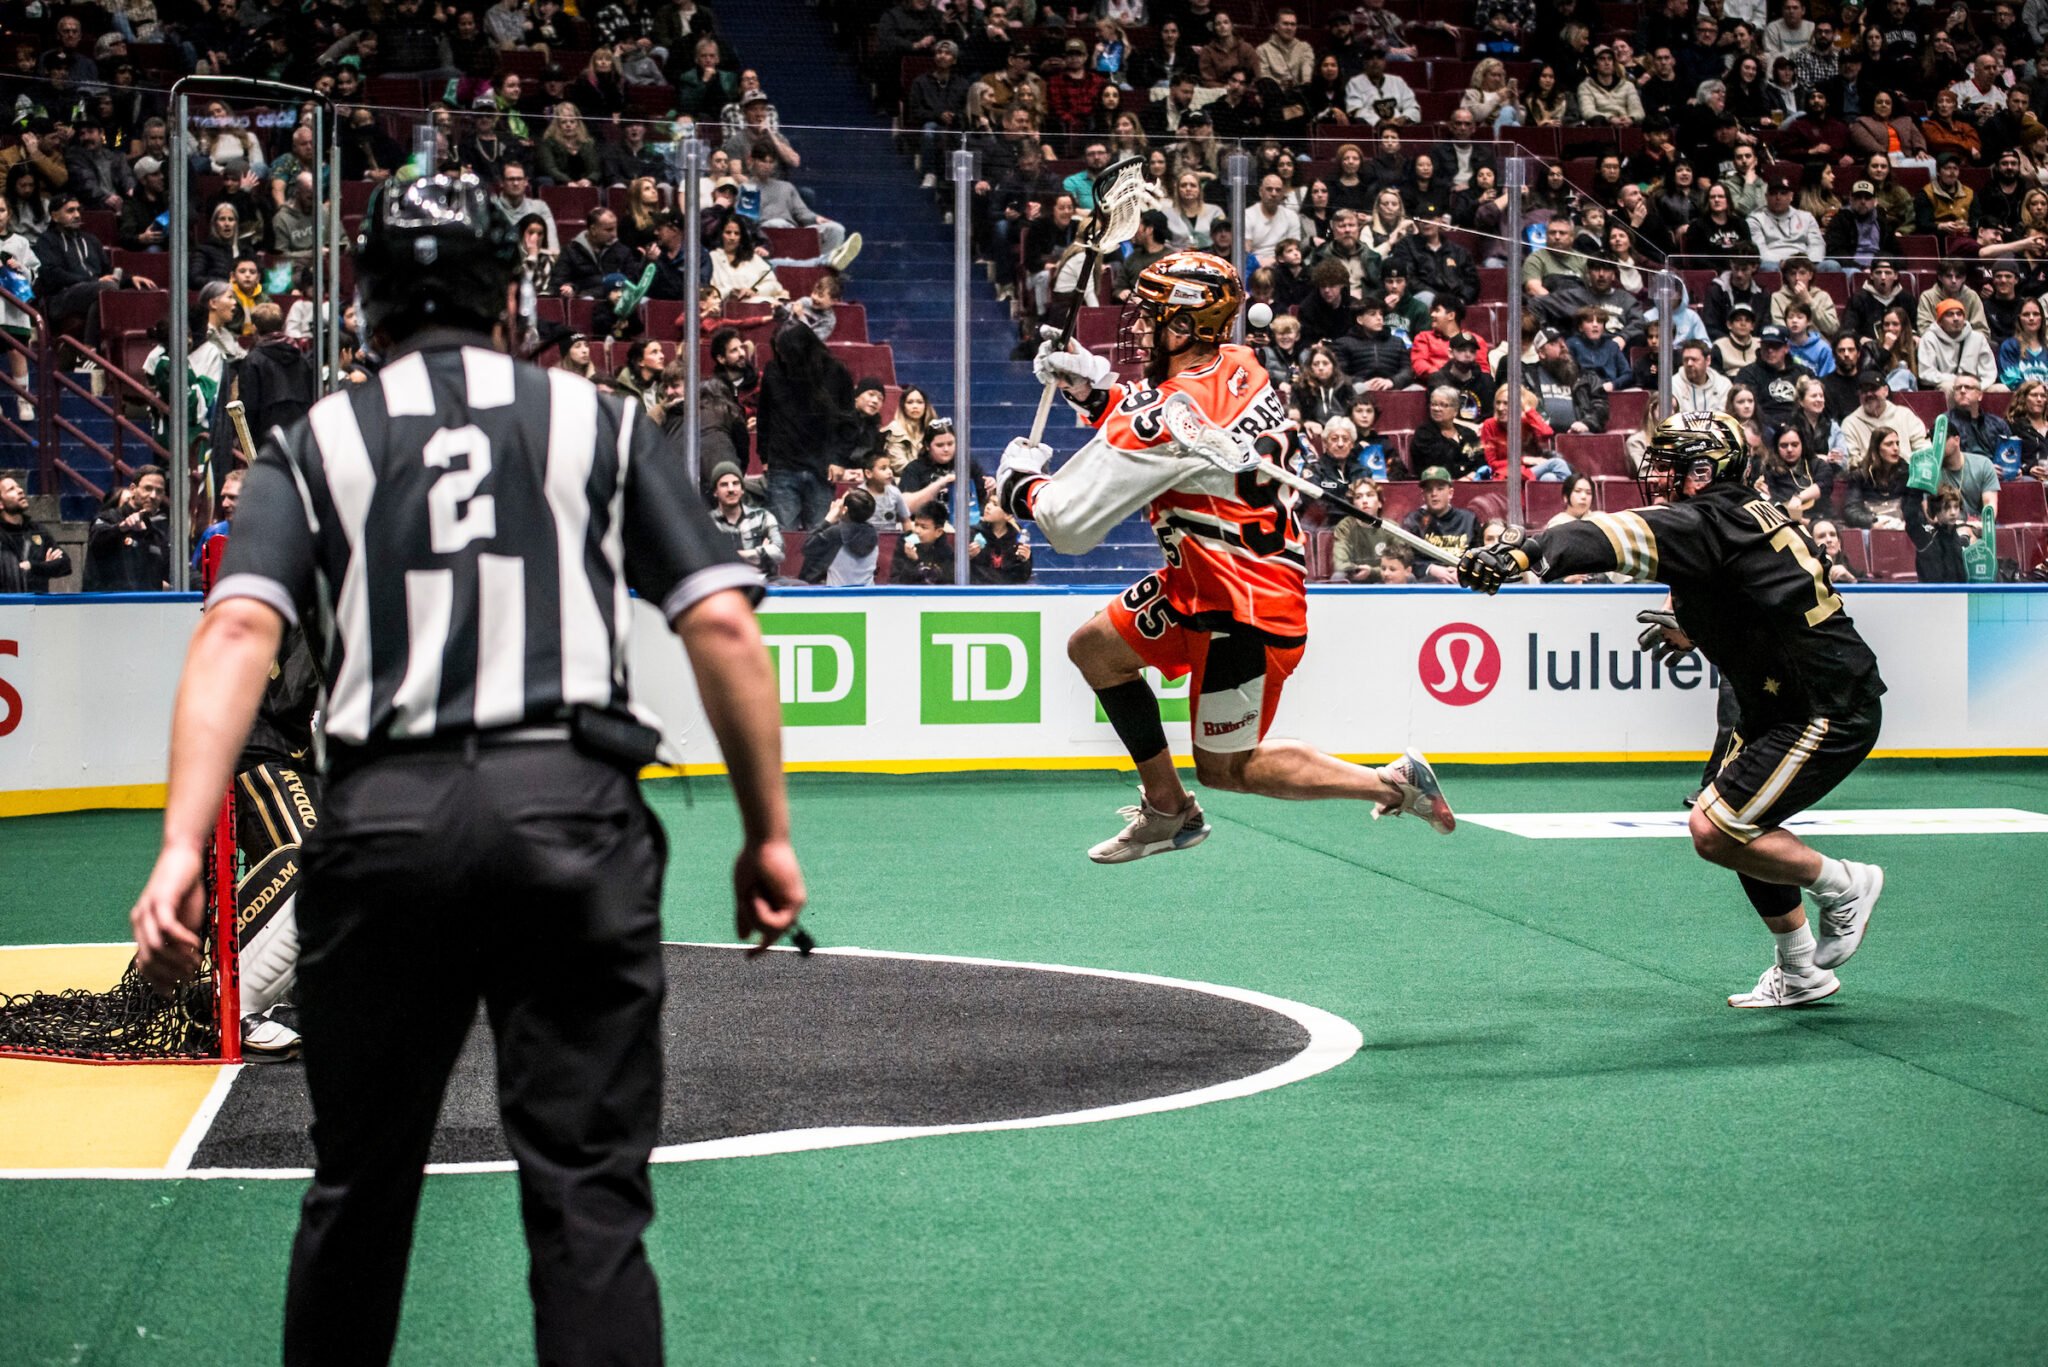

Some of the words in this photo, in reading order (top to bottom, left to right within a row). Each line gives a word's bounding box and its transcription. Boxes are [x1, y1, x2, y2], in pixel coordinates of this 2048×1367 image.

[422, 424, 496, 554] 2
[1121, 574, 1178, 640] 95
[932, 633, 1029, 701] TD
